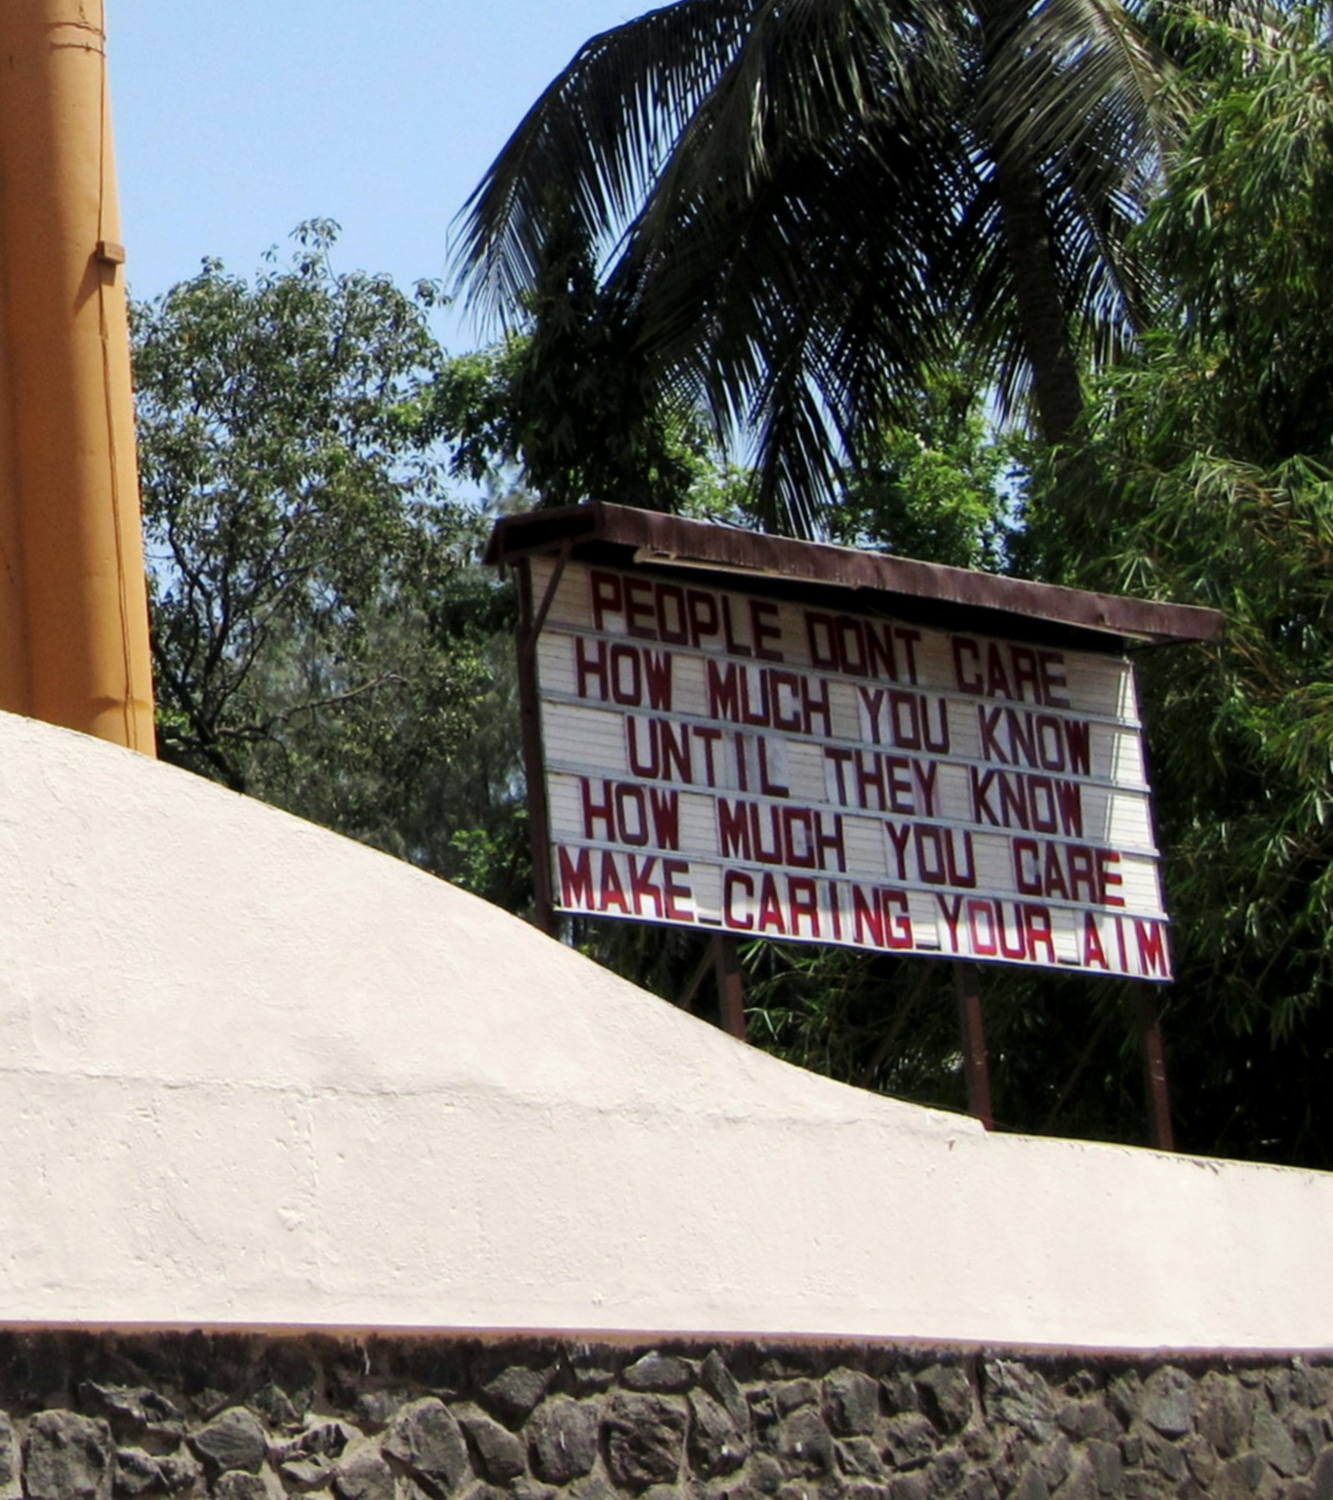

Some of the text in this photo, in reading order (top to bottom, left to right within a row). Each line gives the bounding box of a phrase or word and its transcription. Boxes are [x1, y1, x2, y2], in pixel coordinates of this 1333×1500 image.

[591, 570, 1069, 709] PEOPLE DONT CARE
[575, 637, 1090, 776] HOW MUCH YOU KNOW
[580, 776, 1125, 906] HOW MUCH YOU CARE
[627, 716, 1083, 838] UNTIL THEY KNOW
[557, 845, 1169, 976] MAKE CARING YOUR AIM
